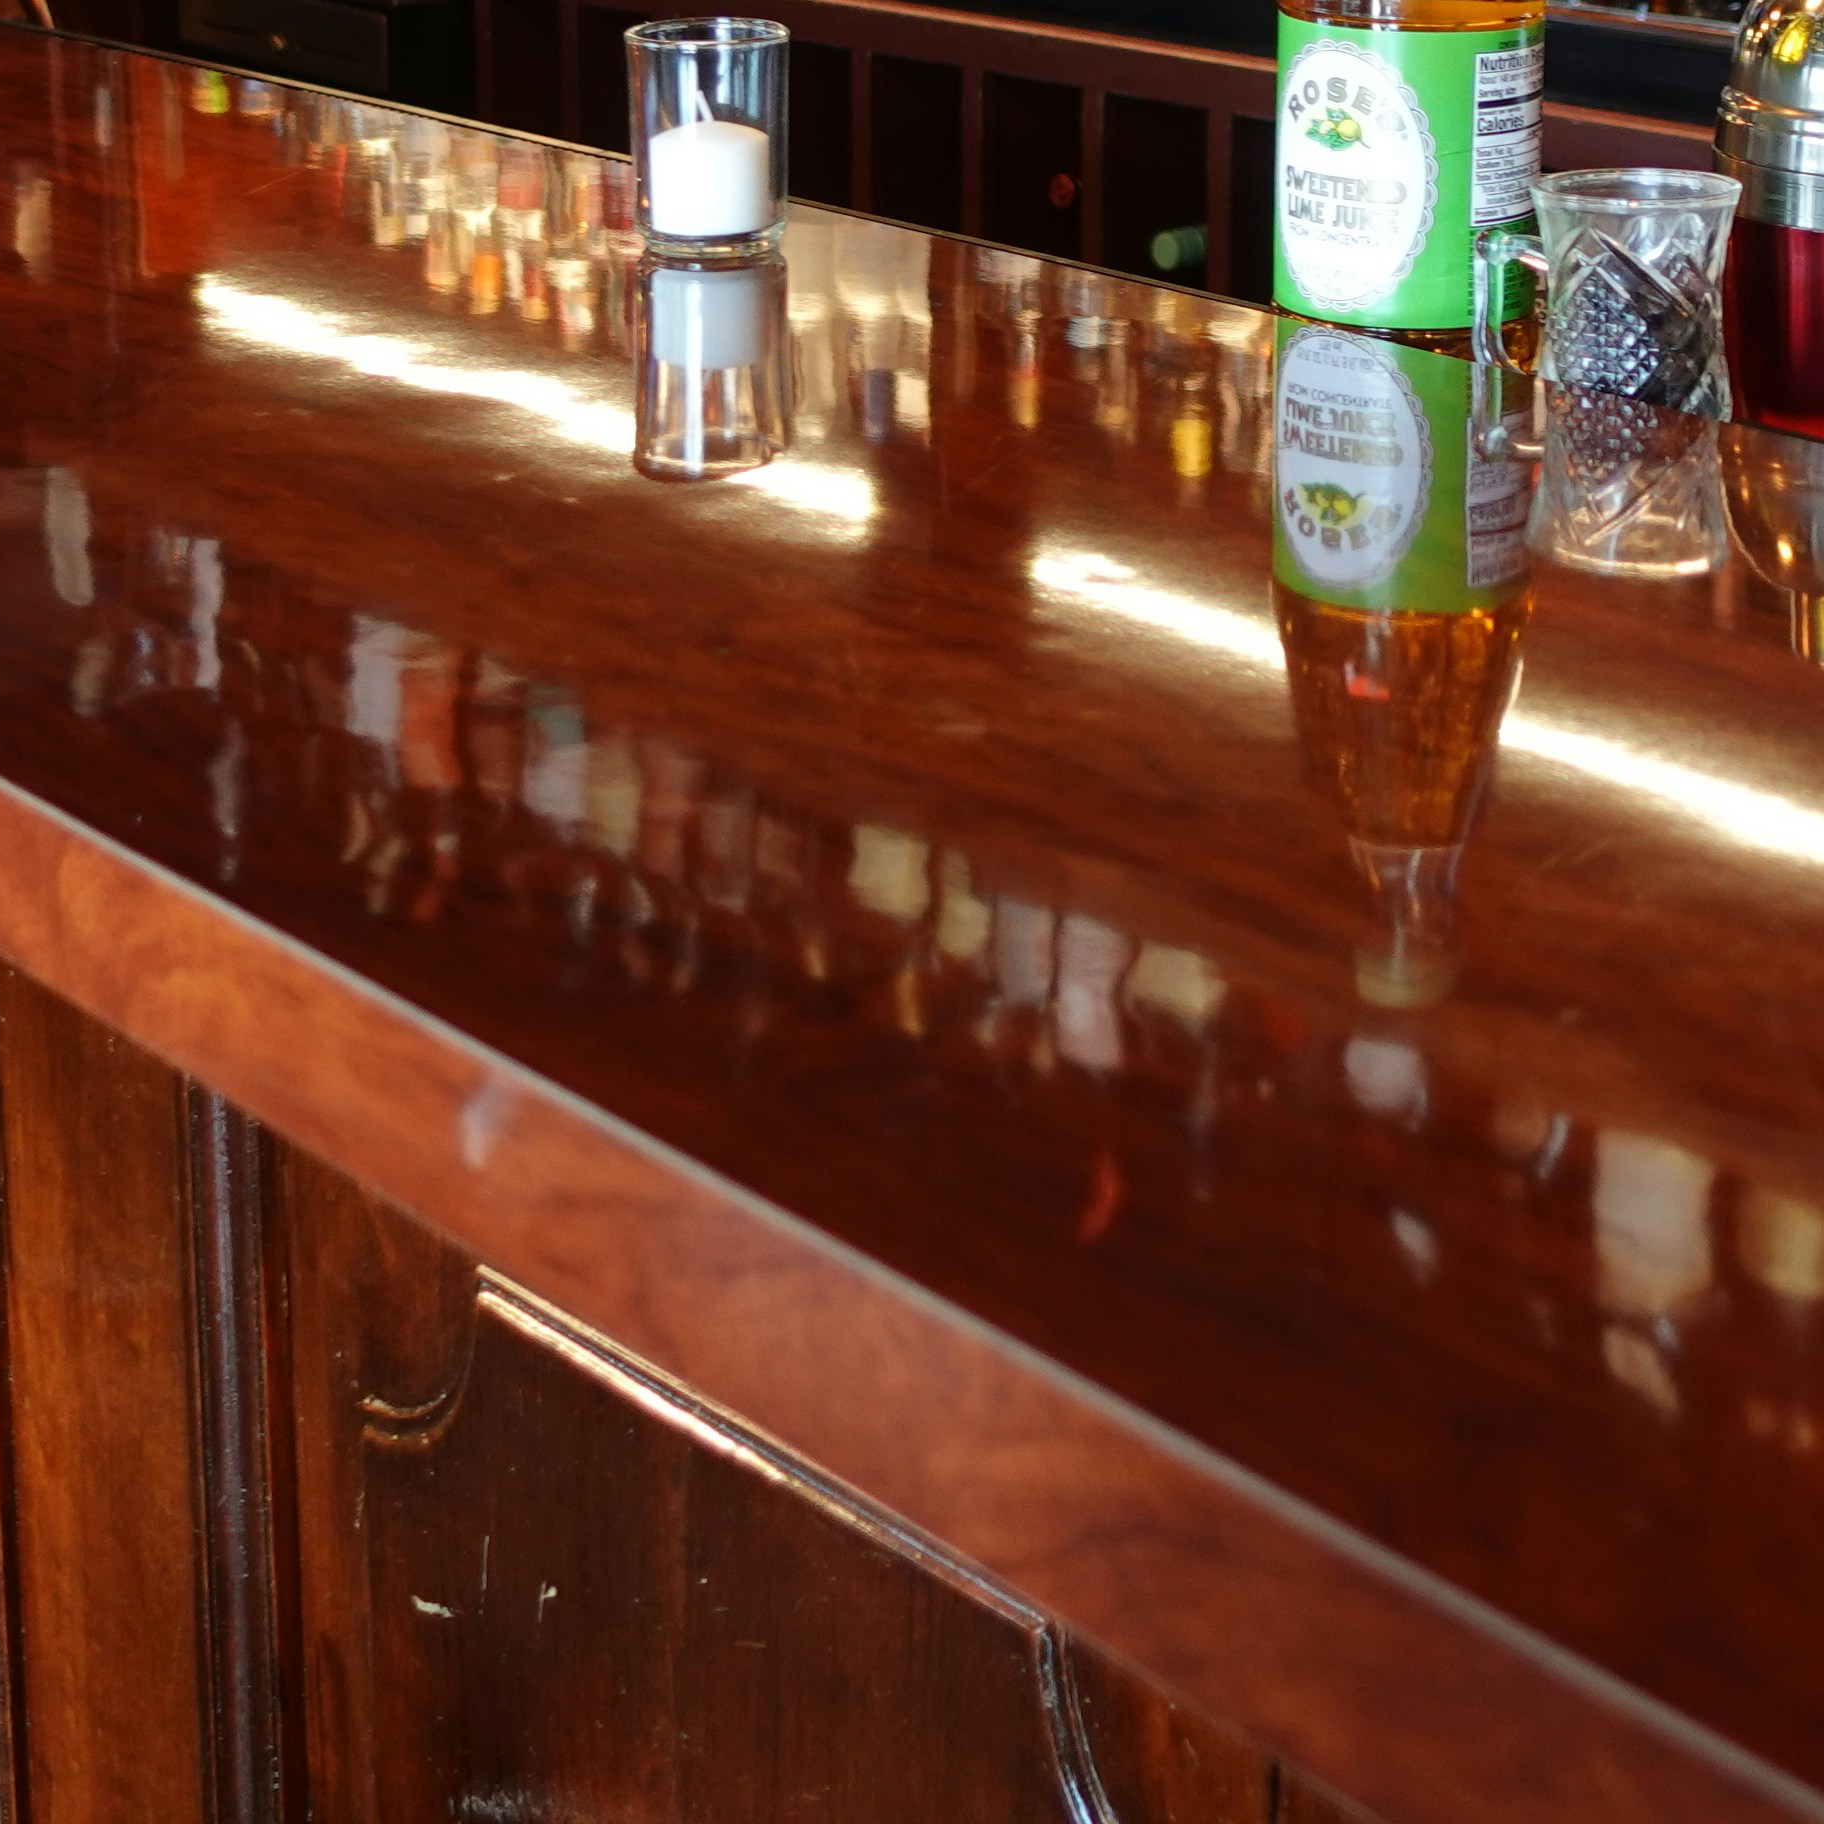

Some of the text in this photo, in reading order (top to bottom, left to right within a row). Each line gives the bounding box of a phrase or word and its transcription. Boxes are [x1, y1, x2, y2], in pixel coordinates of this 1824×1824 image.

[1479, 49, 1529, 73] Nutrition
[1476, 115, 1525, 133] Calories
[1286, 164, 1408, 205] SWEETENED
[1287, 193, 1400, 232] LIME JUICE
